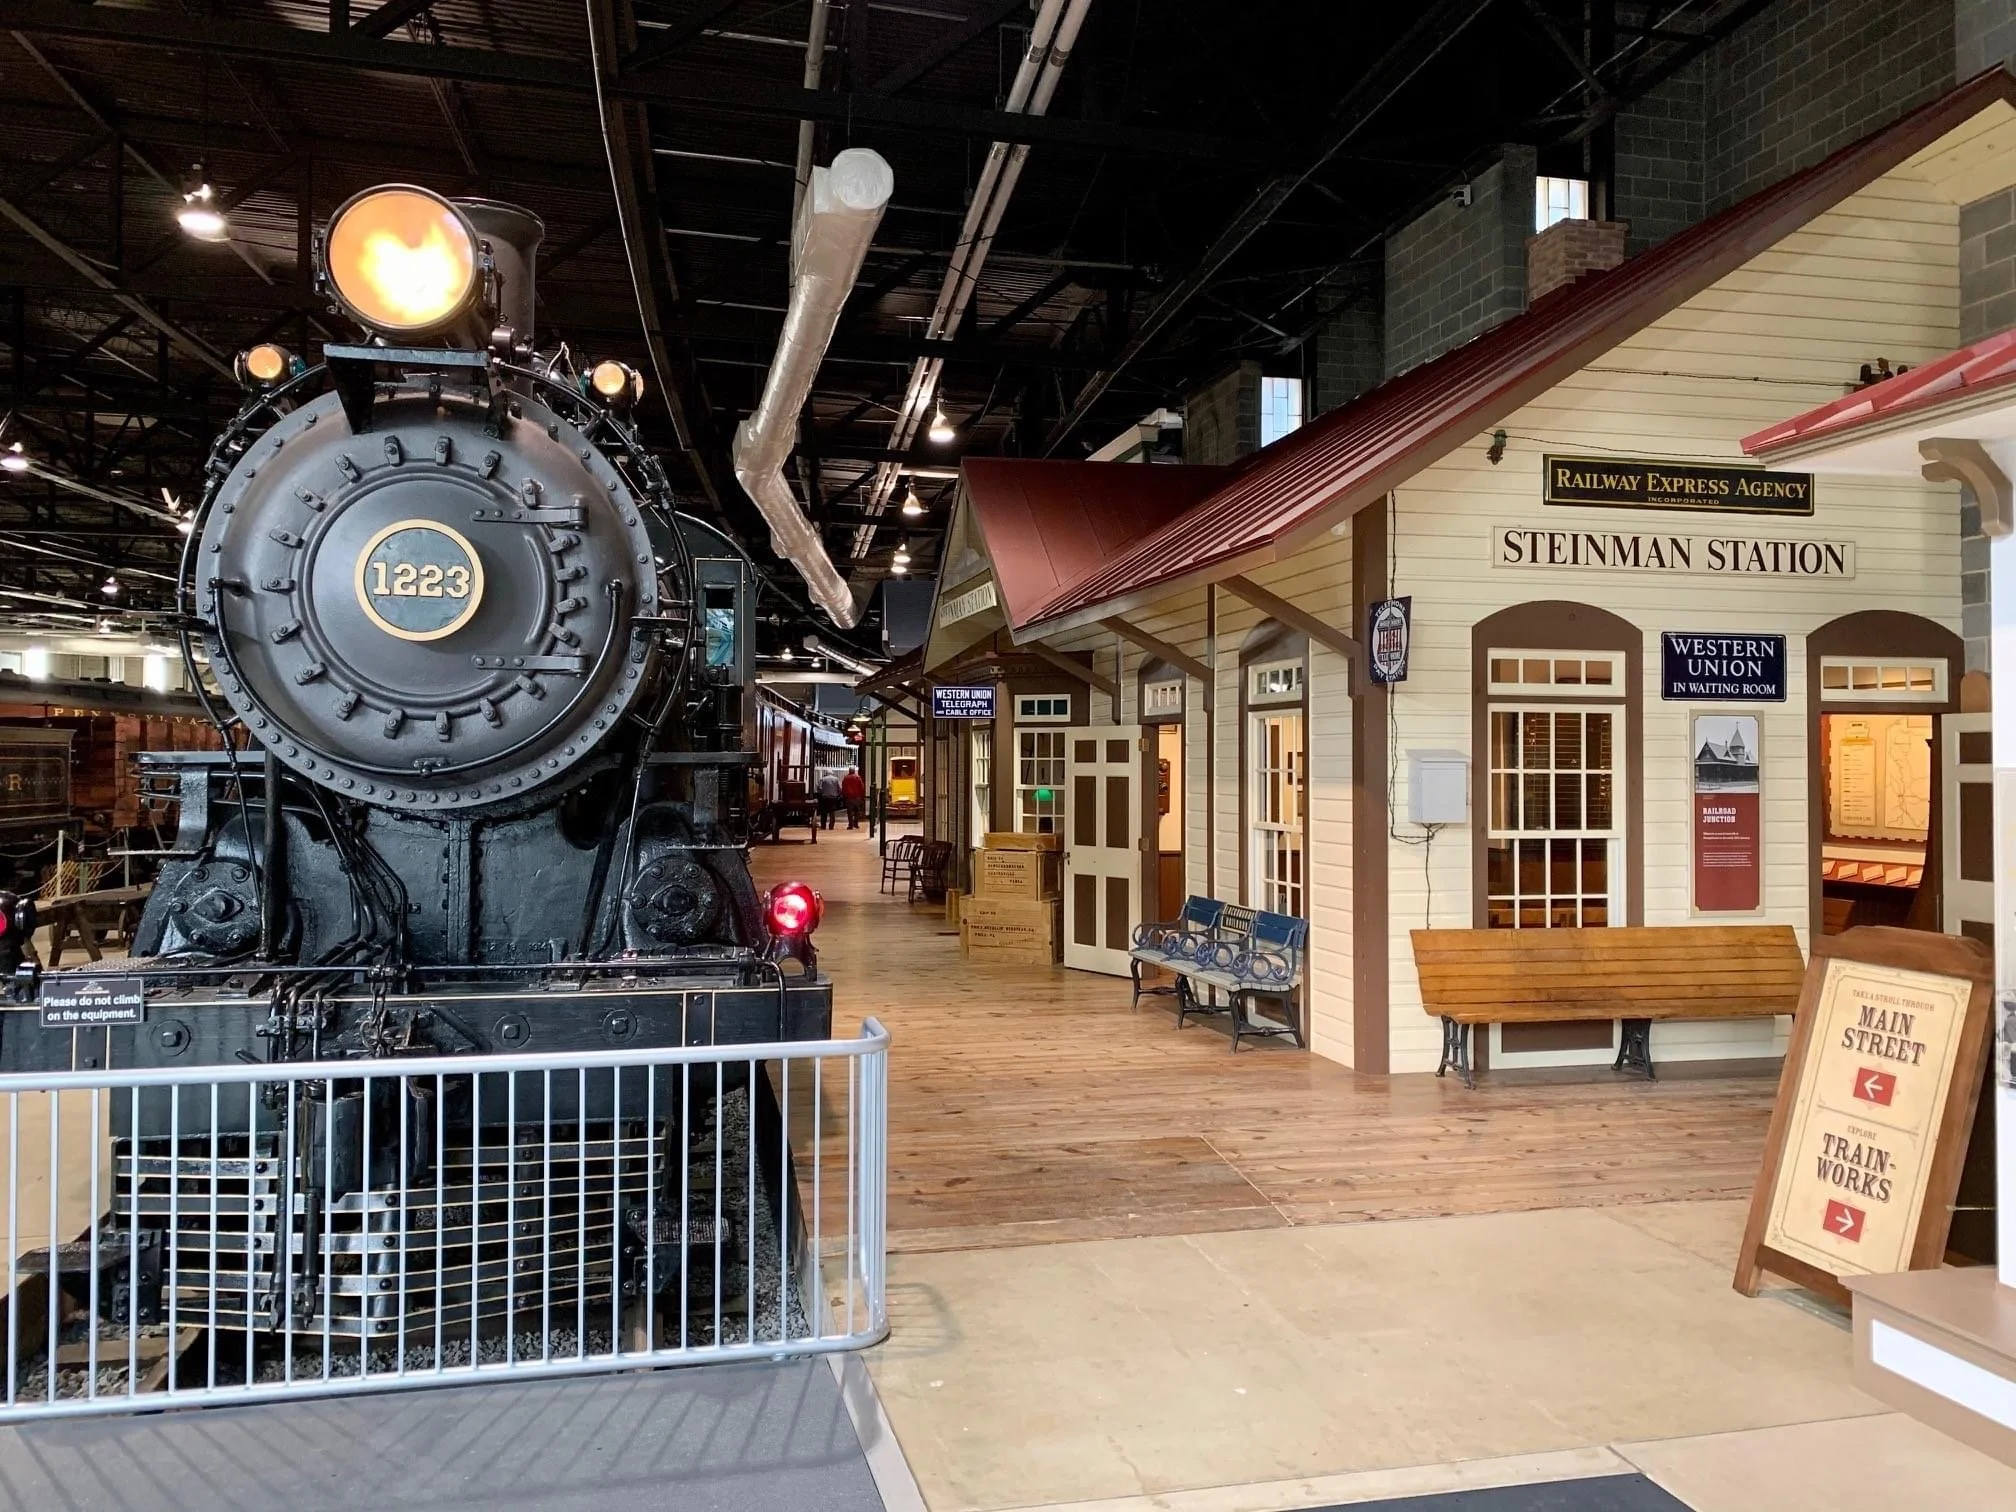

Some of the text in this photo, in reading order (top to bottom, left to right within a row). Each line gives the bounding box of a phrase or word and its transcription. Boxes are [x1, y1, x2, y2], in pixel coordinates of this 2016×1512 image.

[1556, 468, 1808, 498] RAILWAY EXPRESS AGENCY
[1648, 496, 1719, 505] INCORPORATED
[1503, 530, 1846, 574] STEINMAN STATION
[372, 561, 471, 599] 1223
[1671, 638, 1775, 657] WESTERN
[1688, 659, 1762, 677] UNION
[936, 689, 992, 699] WESTERN UNION
[1673, 682, 1776, 695] IN WAITING ROOM
[941, 700, 988, 708] TELEGRAPH
[1702, 807, 1737, 815] RAILROAD
[1702, 815, 1736, 823] JUNCTION
[43, 994, 140, 1007] Please do not climb
[47, 1008, 136, 1021] on the equipment.
[1858, 1004, 1916, 1037] MAIN
[1841, 1027, 1926, 1066] STREET
[1846, 1125, 1877, 1141] EXPLORE
[1823, 1132, 1896, 1174] TRAIN-
[1817, 1156, 1892, 1202] WORKS
